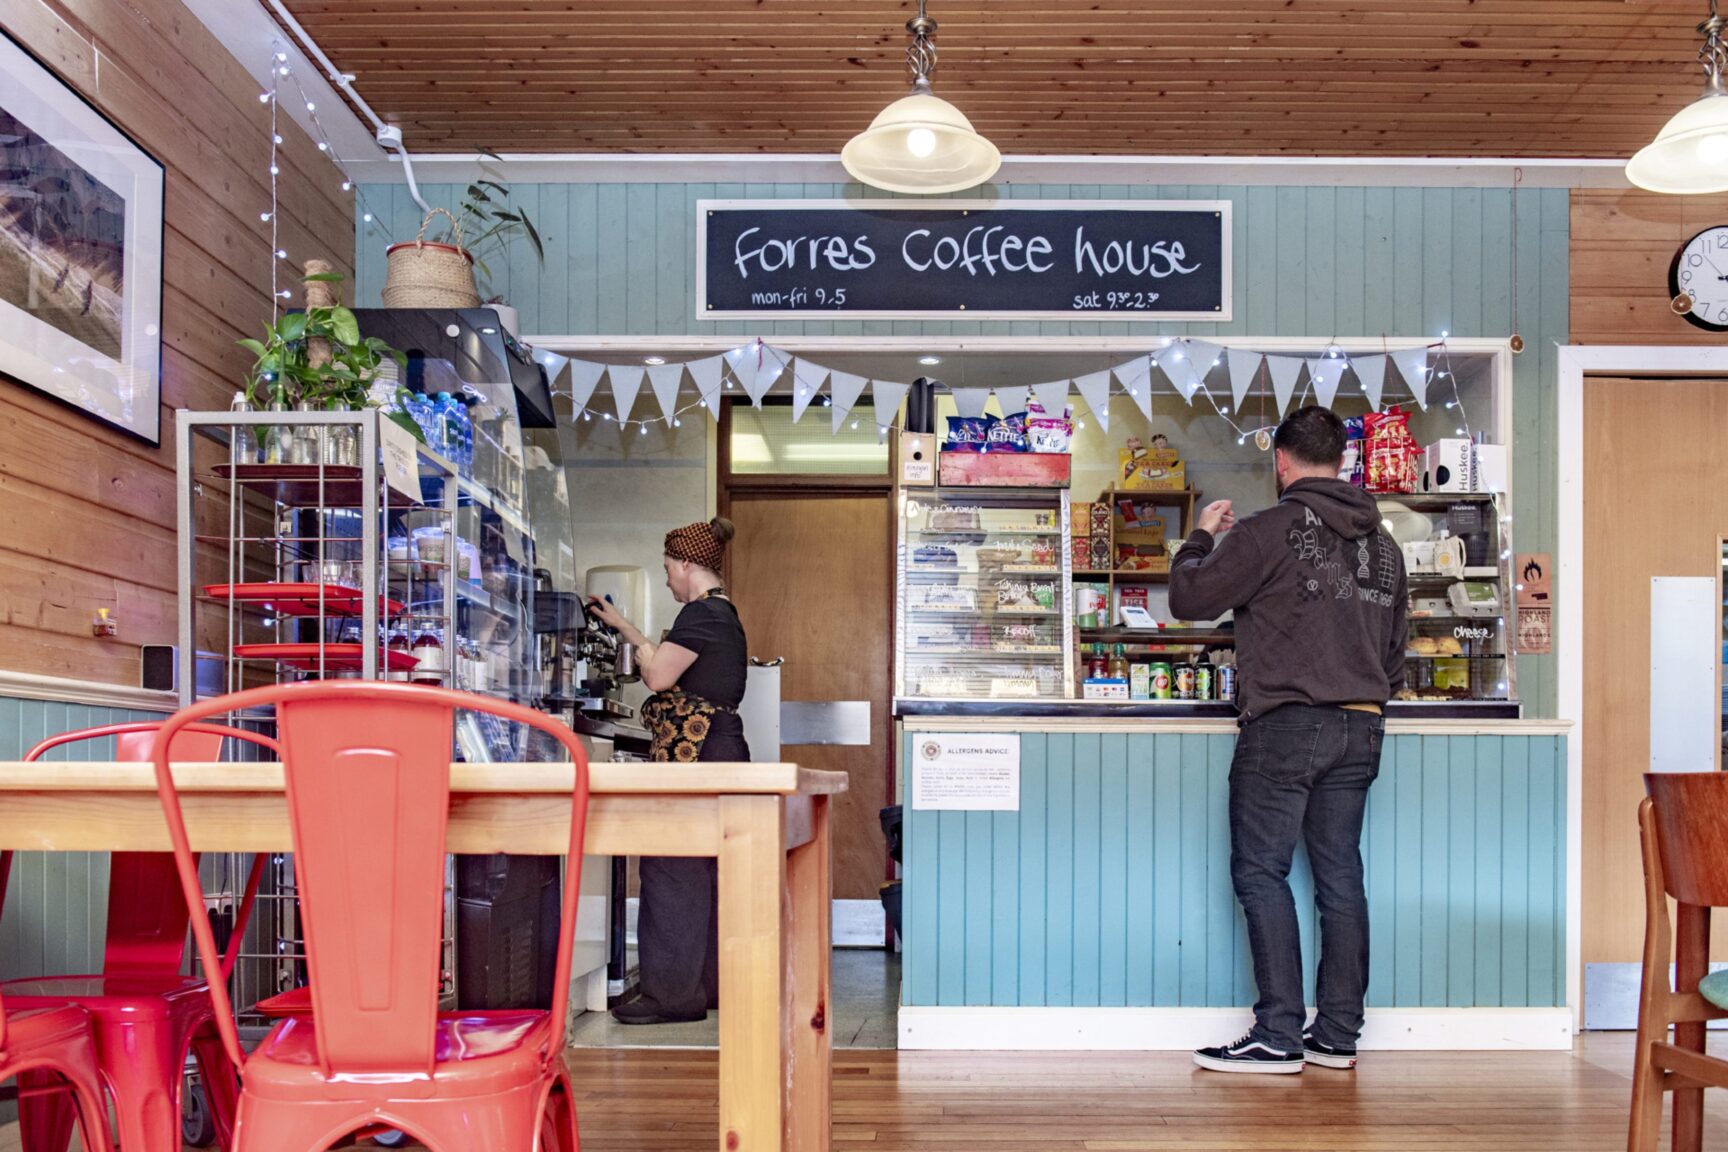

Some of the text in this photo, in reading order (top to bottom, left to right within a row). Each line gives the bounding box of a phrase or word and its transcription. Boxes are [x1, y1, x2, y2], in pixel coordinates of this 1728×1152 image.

[902, 226, 1055, 277] Coffee
[1075, 226, 1202, 278] house
[1702, 240, 1712, 254] 11
[1687, 253, 1703, 268] 10
[1681, 270, 1692, 284] 9
[751, 287, 807, 308] mon-fri
[1073, 291, 1101, 309] sat
[1700, 302, 1711, 317] 7
[1304, 506, 1322, 526] A
[1290, 528, 1353, 599] Vans
[1358, 587, 1379, 603] SINCE
[1518, 614, 1551, 624] ROAST
